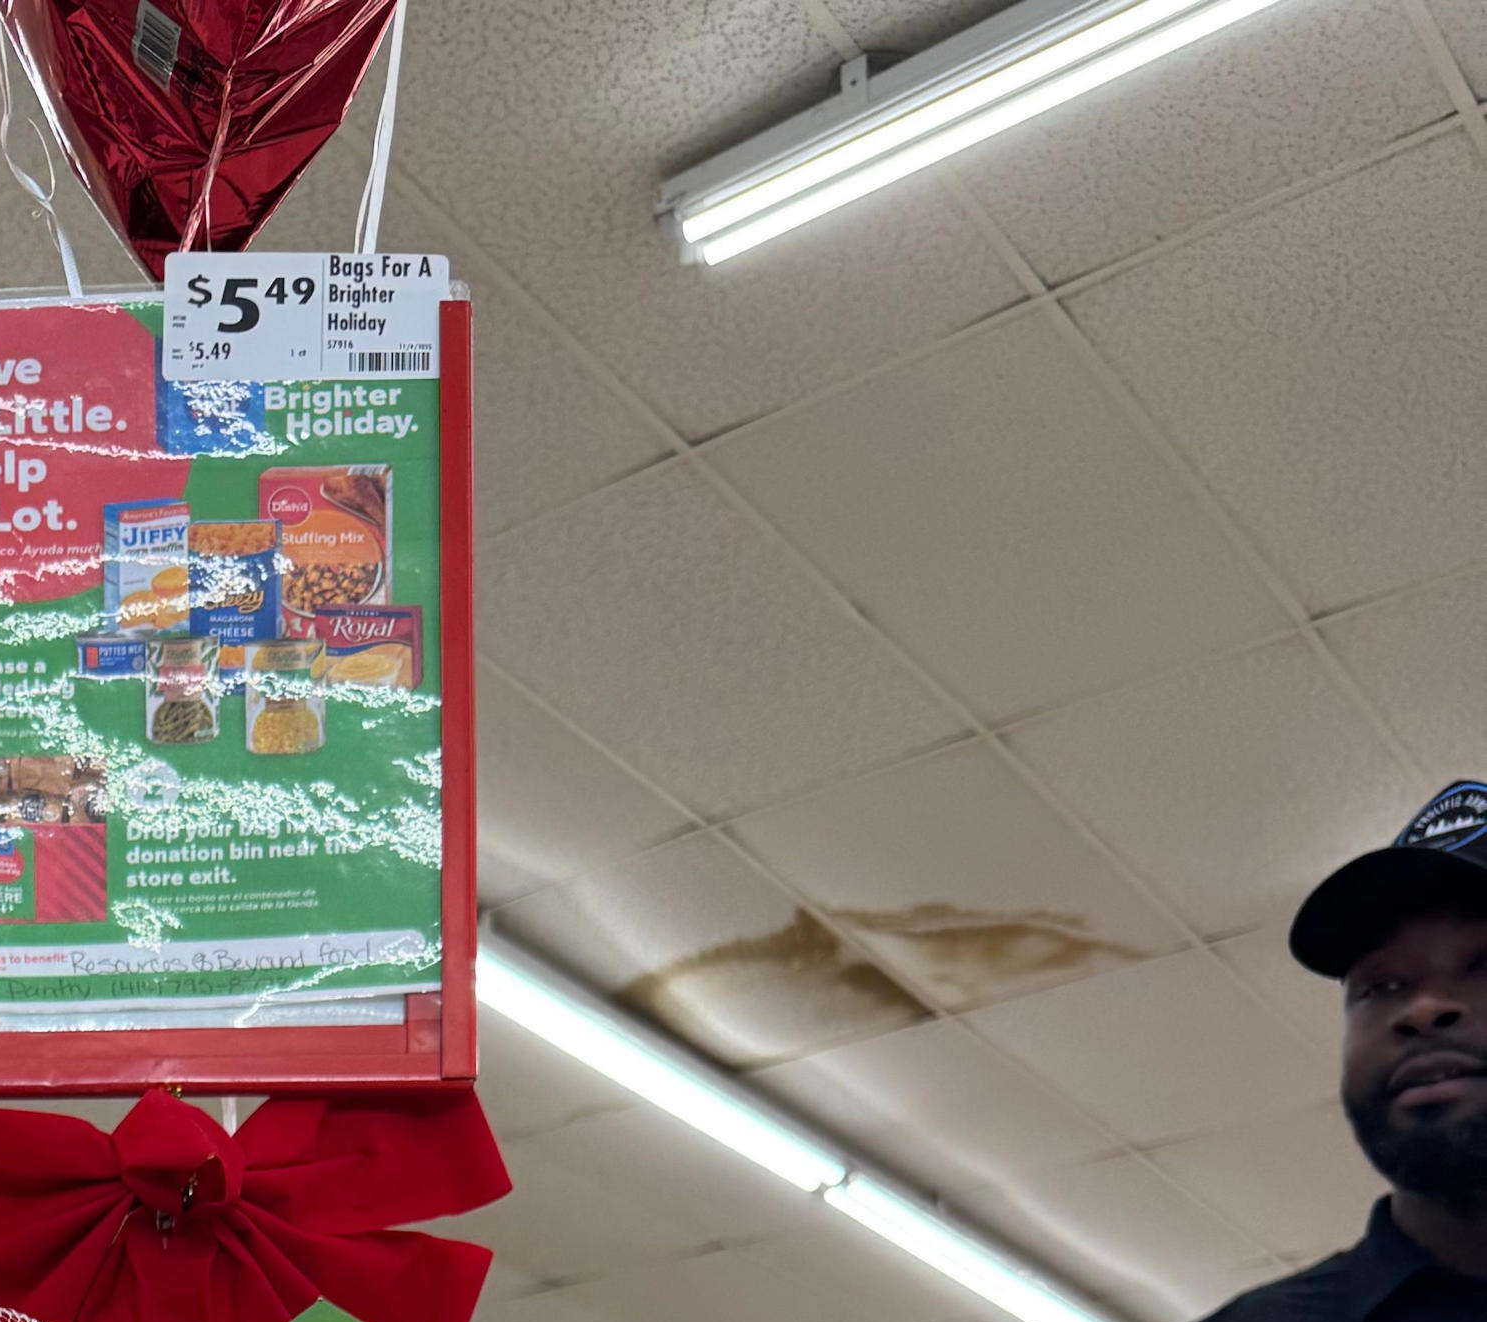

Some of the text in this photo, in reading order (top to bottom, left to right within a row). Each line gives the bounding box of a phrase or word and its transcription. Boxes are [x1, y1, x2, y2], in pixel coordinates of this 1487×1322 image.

[329, 255, 431, 282] Bags For A
[329, 284, 395, 308] Brighter
[327, 313, 386, 335] Holiday
[189, 342, 231, 360] $5.49
[264, 384, 402, 413] Brighter
[286, 411, 419, 438] Holiday.
[282, 532, 364, 547] Stuffing Mix
[23, 545, 64, 558] Ayuda
[210, 628, 254, 638] CHEESE
[330, 617, 395, 640] Royal
[33, 662, 46, 673] a
[186, 823, 232, 843] your
[127, 840, 317, 864] donation bin near
[127, 867, 236, 887] store exit.
[9, 955, 22, 963] to
